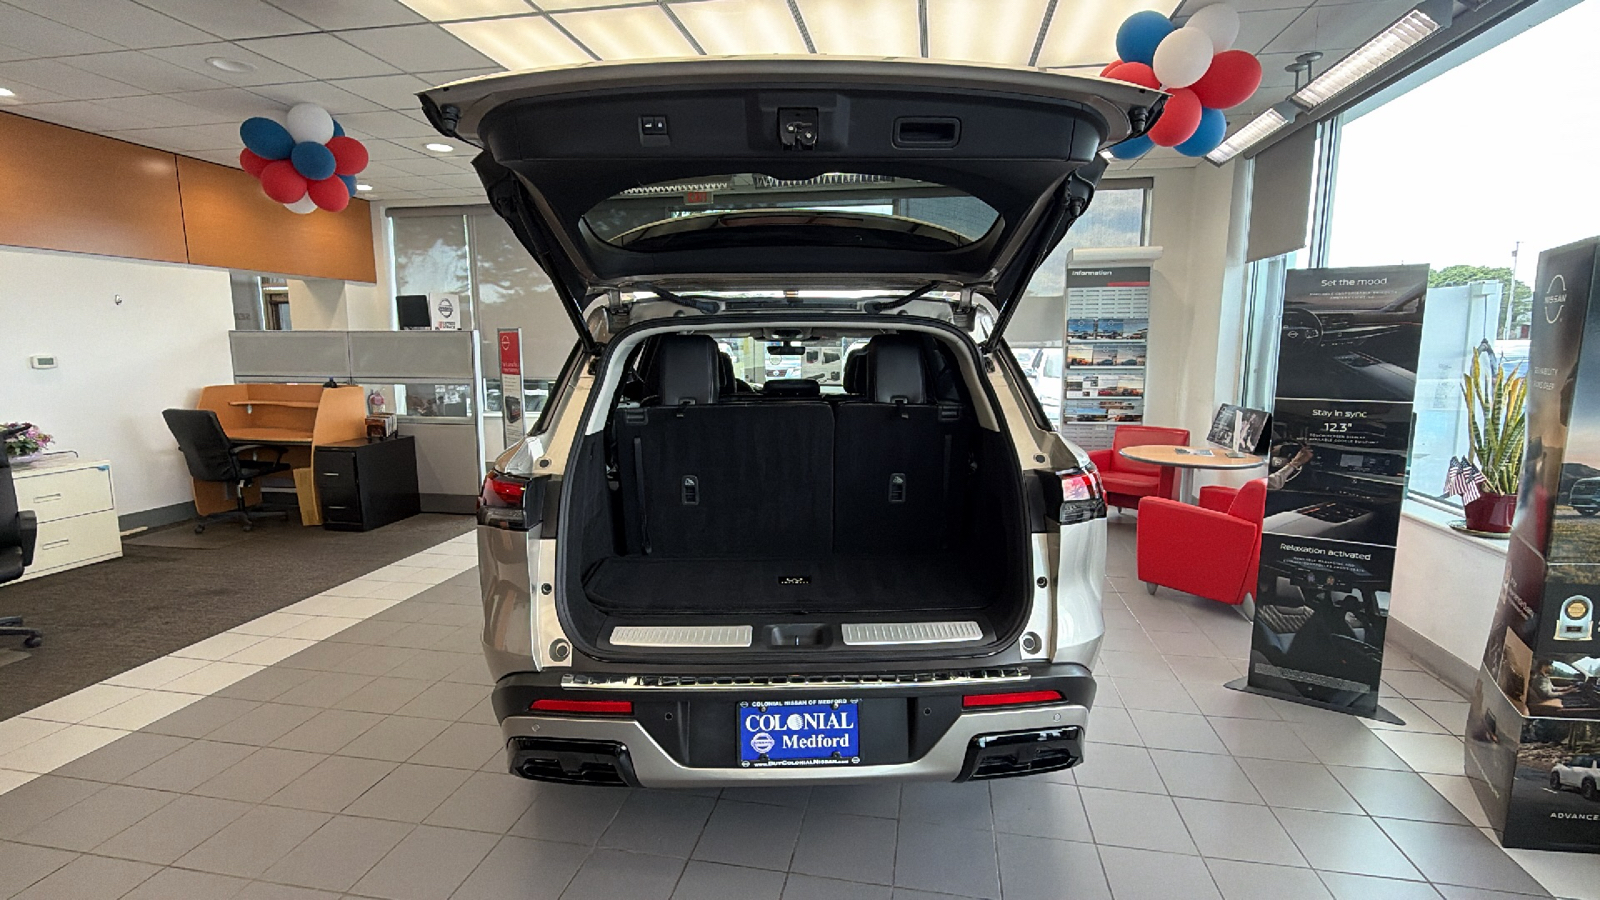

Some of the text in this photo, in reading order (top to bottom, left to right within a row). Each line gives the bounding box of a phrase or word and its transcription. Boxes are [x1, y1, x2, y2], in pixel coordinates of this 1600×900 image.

[1321, 277, 1388, 287] Set the mood
[1312, 409, 1333, 418] Stay
[1344, 411, 1368, 419] sync
[1324, 422, 1353, 433] 12.3"
[1280, 543, 1372, 561] Relaxation activated
[745, 712, 854, 732] COLONIAL
[782, 733, 850, 749] Medford
[1550, 812, 1600, 821] ADVANCE
